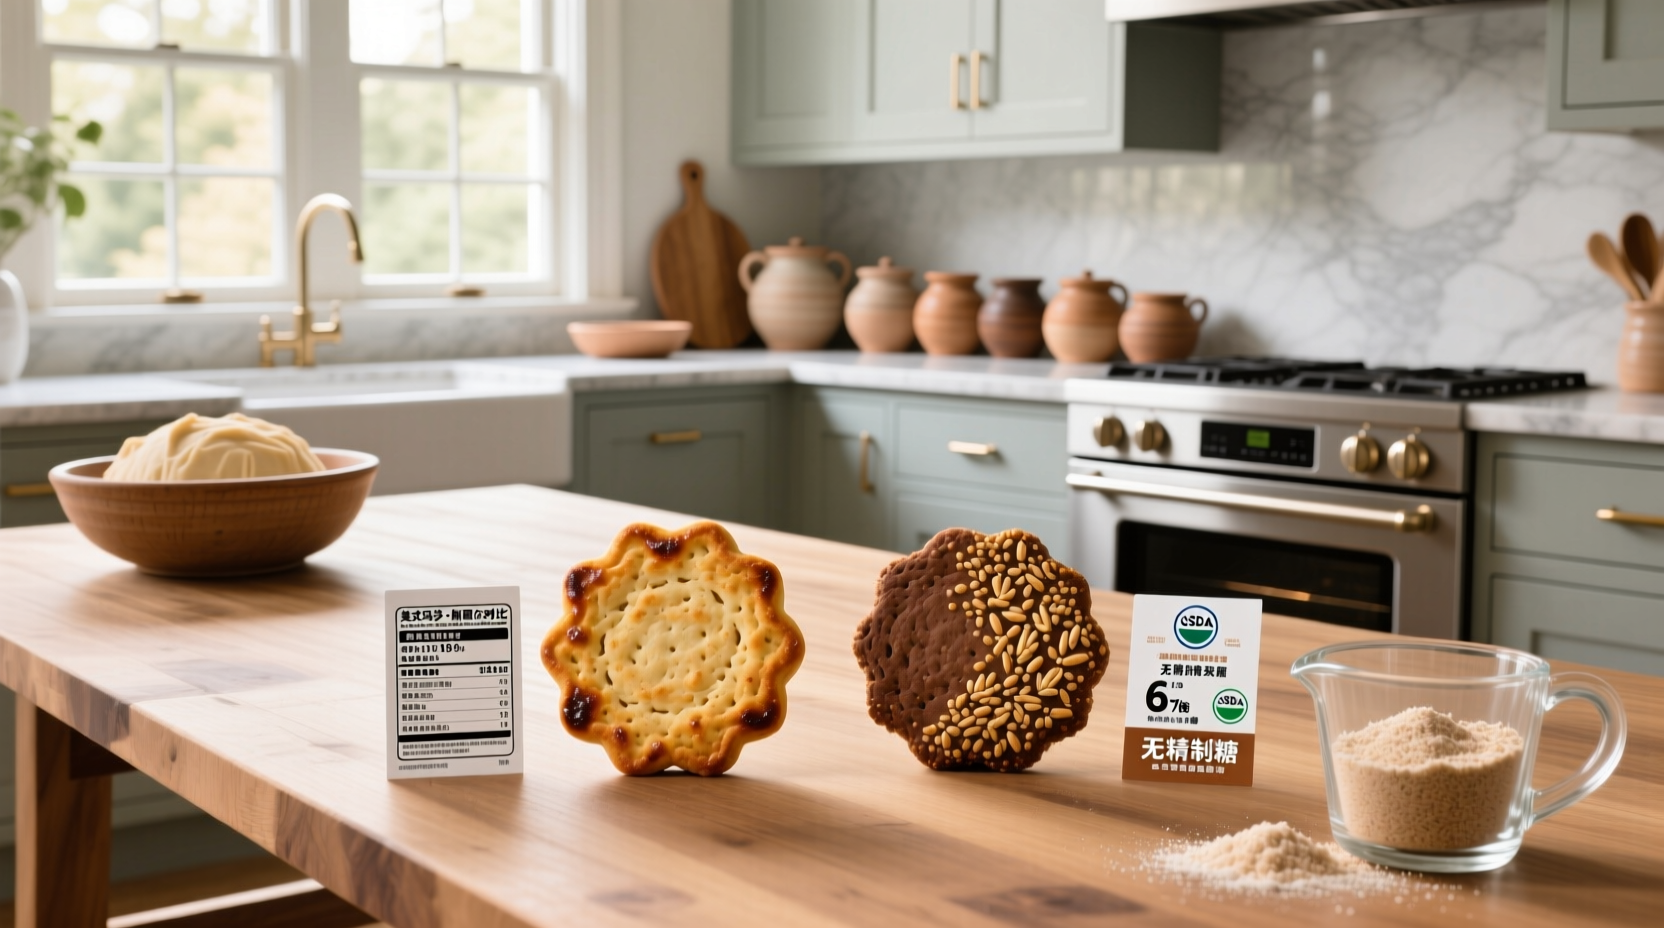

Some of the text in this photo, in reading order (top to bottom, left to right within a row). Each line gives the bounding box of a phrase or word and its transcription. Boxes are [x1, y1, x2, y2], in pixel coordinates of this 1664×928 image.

[1145, 680, 1168, 713] 6
[1141, 736, 1239, 764] 无精制糖
